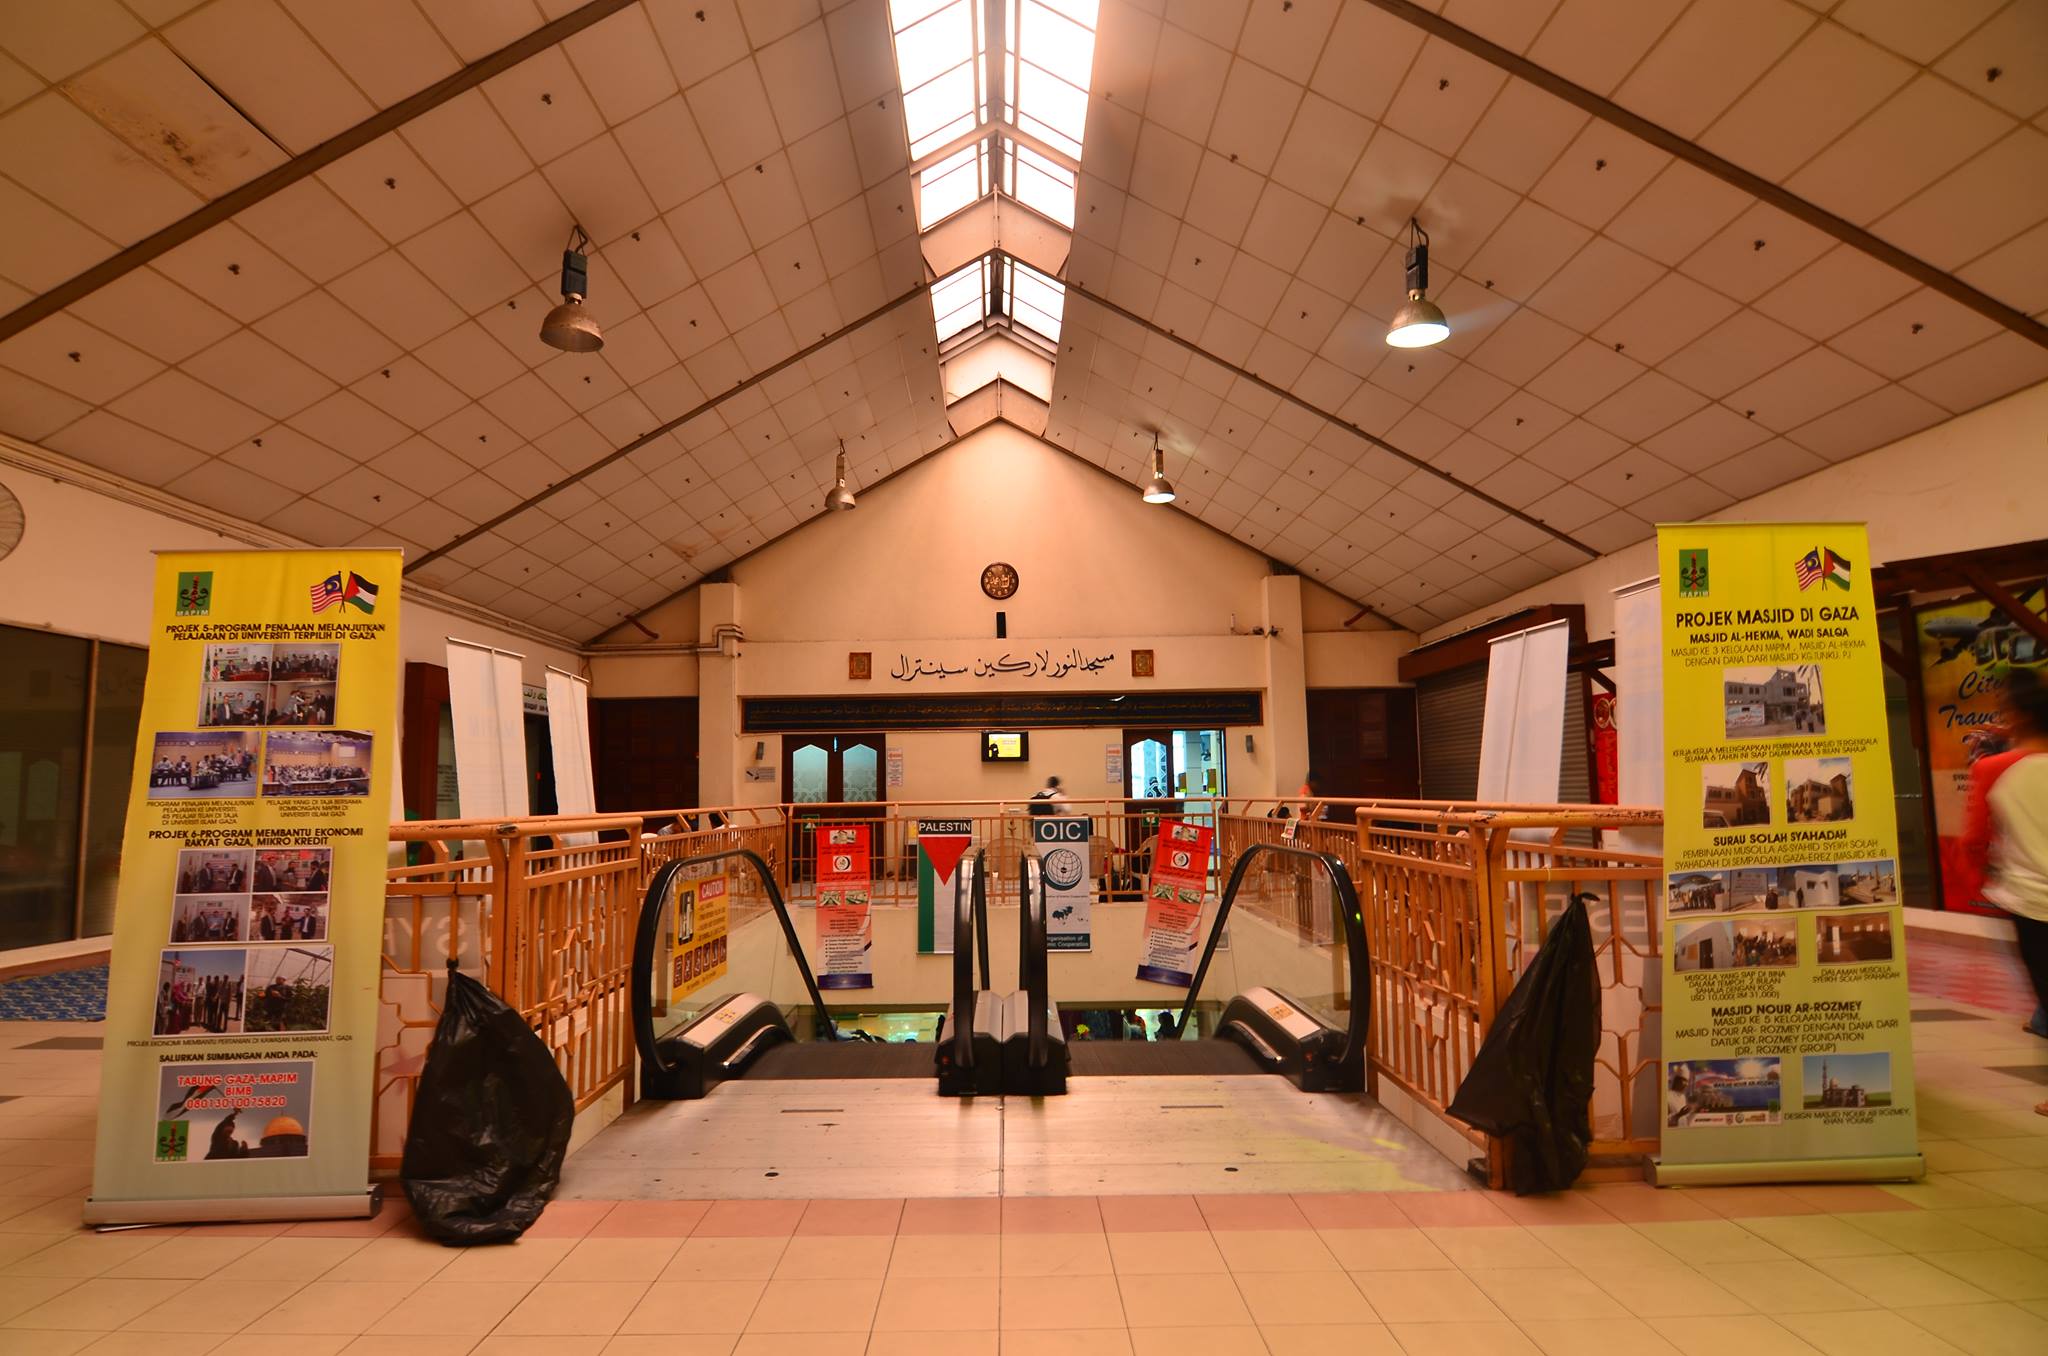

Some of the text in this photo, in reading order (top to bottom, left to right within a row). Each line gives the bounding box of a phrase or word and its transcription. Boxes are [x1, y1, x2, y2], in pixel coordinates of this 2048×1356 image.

[176, 609, 209, 617] MAPIM
[1676, 606, 1859, 628] PROJEK MASJID DI GAZA
[166, 623, 386, 633] PROJEK 5-PROGRAM PENAJAAN MELANJUTKAN
[173, 631, 377, 640] PELAJARAN DI UNIVERSITI TERPILIH DI GAZA
[1690, 627, 1849, 644] MASJID AL-HEKMA, WADI SALQA
[1671, 648, 1698, 657] MASJID
[1700, 647, 1710, 655] KE
[1713, 646, 1719, 655] 3
[1721, 644, 1763, 654] KELOLAAN
[1799, 641, 1826, 651] MASJID
[1685, 652, 1798, 667] DENGAN DANA DARI MASJID
[1791, 748, 1814, 756] MASA
[148, 827, 364, 839] PROJEK 6-PROGRAM MEMBANTU EKONOMI
[918, 822, 971, 832] PALESTIN
[1040, 822, 1081, 840] OIC
[184, 836, 329, 847] RAKYAT GAZA, MIKRO KREDIT
[1713, 829, 1847, 846] SURAU SOLAH SYAHADAH
[1682, 848, 1732, 859] PEMBINAAN
[1733, 845, 1775, 855] MUSOLLA
[1849, 839, 1878, 849] SOLAH
[1674, 859, 1719, 871] SYAHADAH
[1721, 858, 1731, 868] DI
[1731, 855, 1780, 865] SEMPADAN
[1783, 852, 1832, 863] GAZA-EREZ
[1711, 1000, 1863, 1017] MASJID NOUR AR-ROZMEY
[1713, 1017, 1746, 1027] MASJID
[1749, 1015, 1760, 1025] KE
[1764, 1015, 1771, 1024] 5
[1774, 1013, 1822, 1024] KELOLAAN
[1675, 1028, 1709, 1039] MASJID
[1712, 1026, 1739, 1037] NOUR
[1760, 1024, 1801, 1034] ROZMEY
[1803, 1022, 1846, 1033] DENGAN
[1848, 1021, 1874, 1031] DANA
[1876, 1018, 1898, 1029] DARI
[1710, 1032, 1865, 1047] DATUK FOUNDATION
[159, 1050, 318, 1062] SALURKAN SUMBANGAN ANDA PADA:
[1756, 1044, 1797, 1054] ROZMEY
[177, 1075, 221, 1086] TABUNG
[225, 1086, 253, 1096] BIMB
